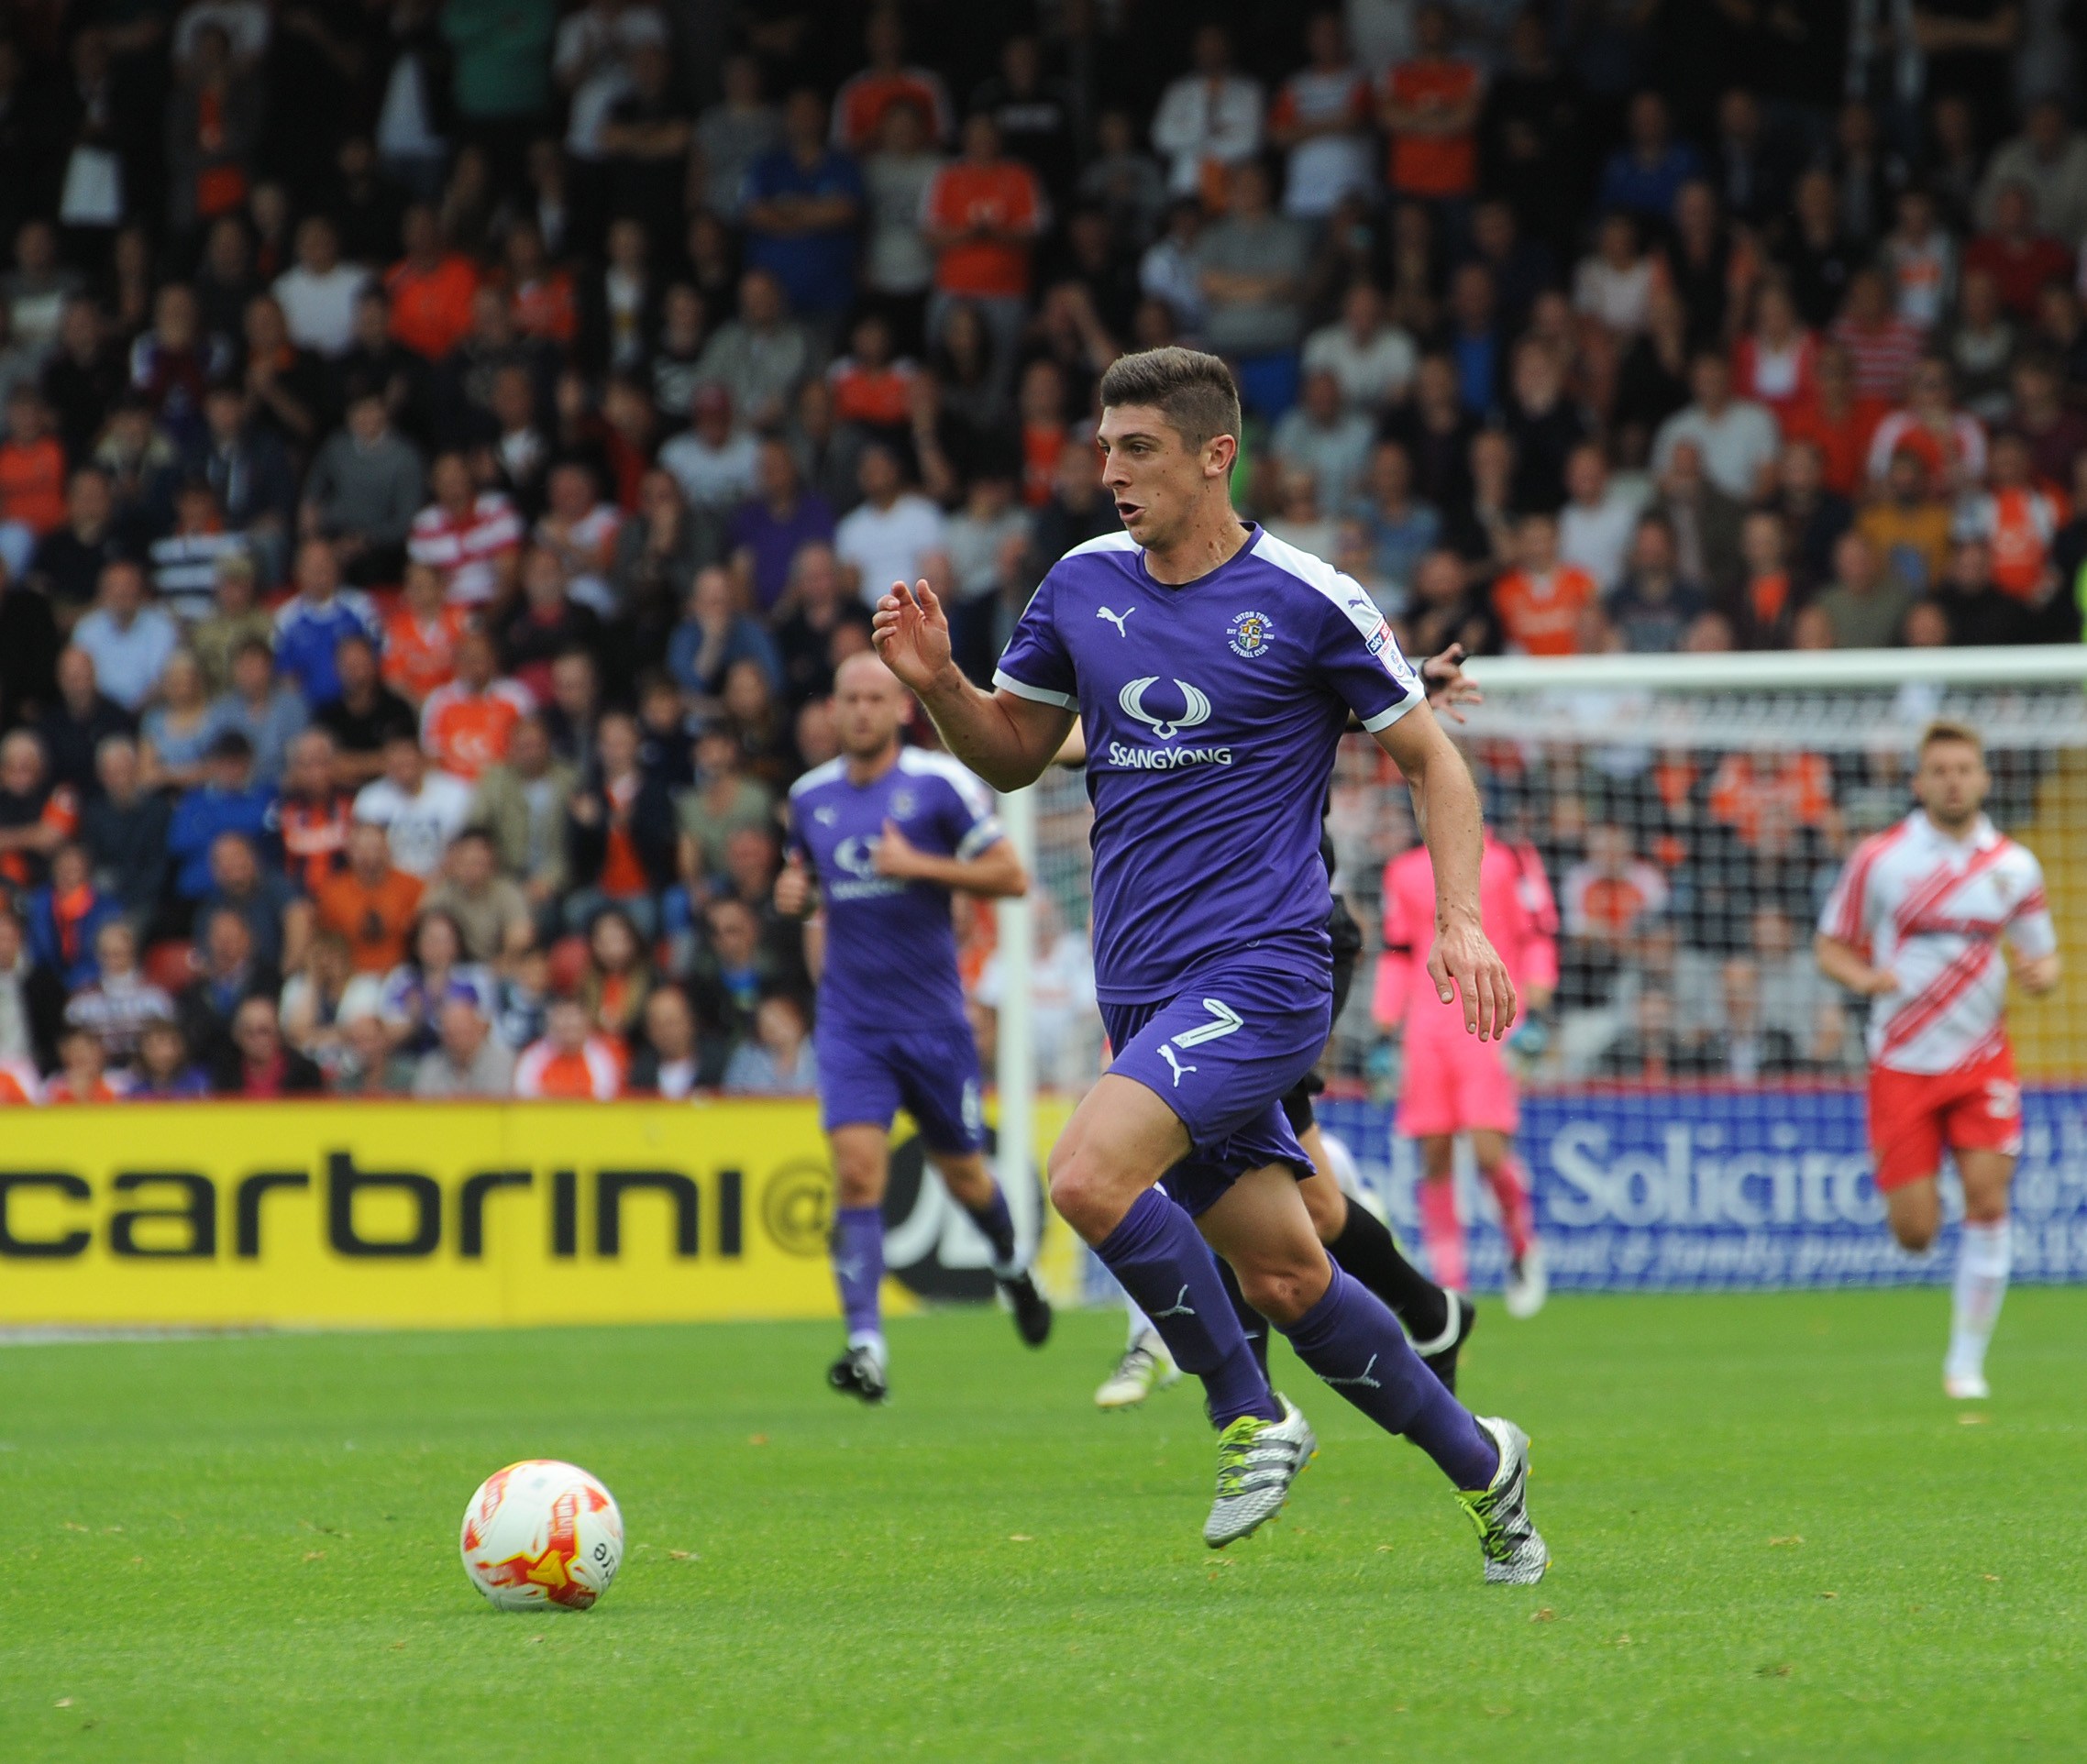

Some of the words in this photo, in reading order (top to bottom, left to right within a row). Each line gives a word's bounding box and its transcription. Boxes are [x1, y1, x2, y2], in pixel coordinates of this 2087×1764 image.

[1231, 611, 1254, 623] LUTON
[1255, 612, 1273, 628] TOWN
[1228, 640, 1254, 657] FOOTBALL
[1253, 644, 1269, 656] CLUB
[1369, 633, 1384, 652] sky
[1170, 998, 1244, 1049] 7
[1550, 1121, 1965, 1227] Solicito
[0, 1151, 744, 1258] carbrini
